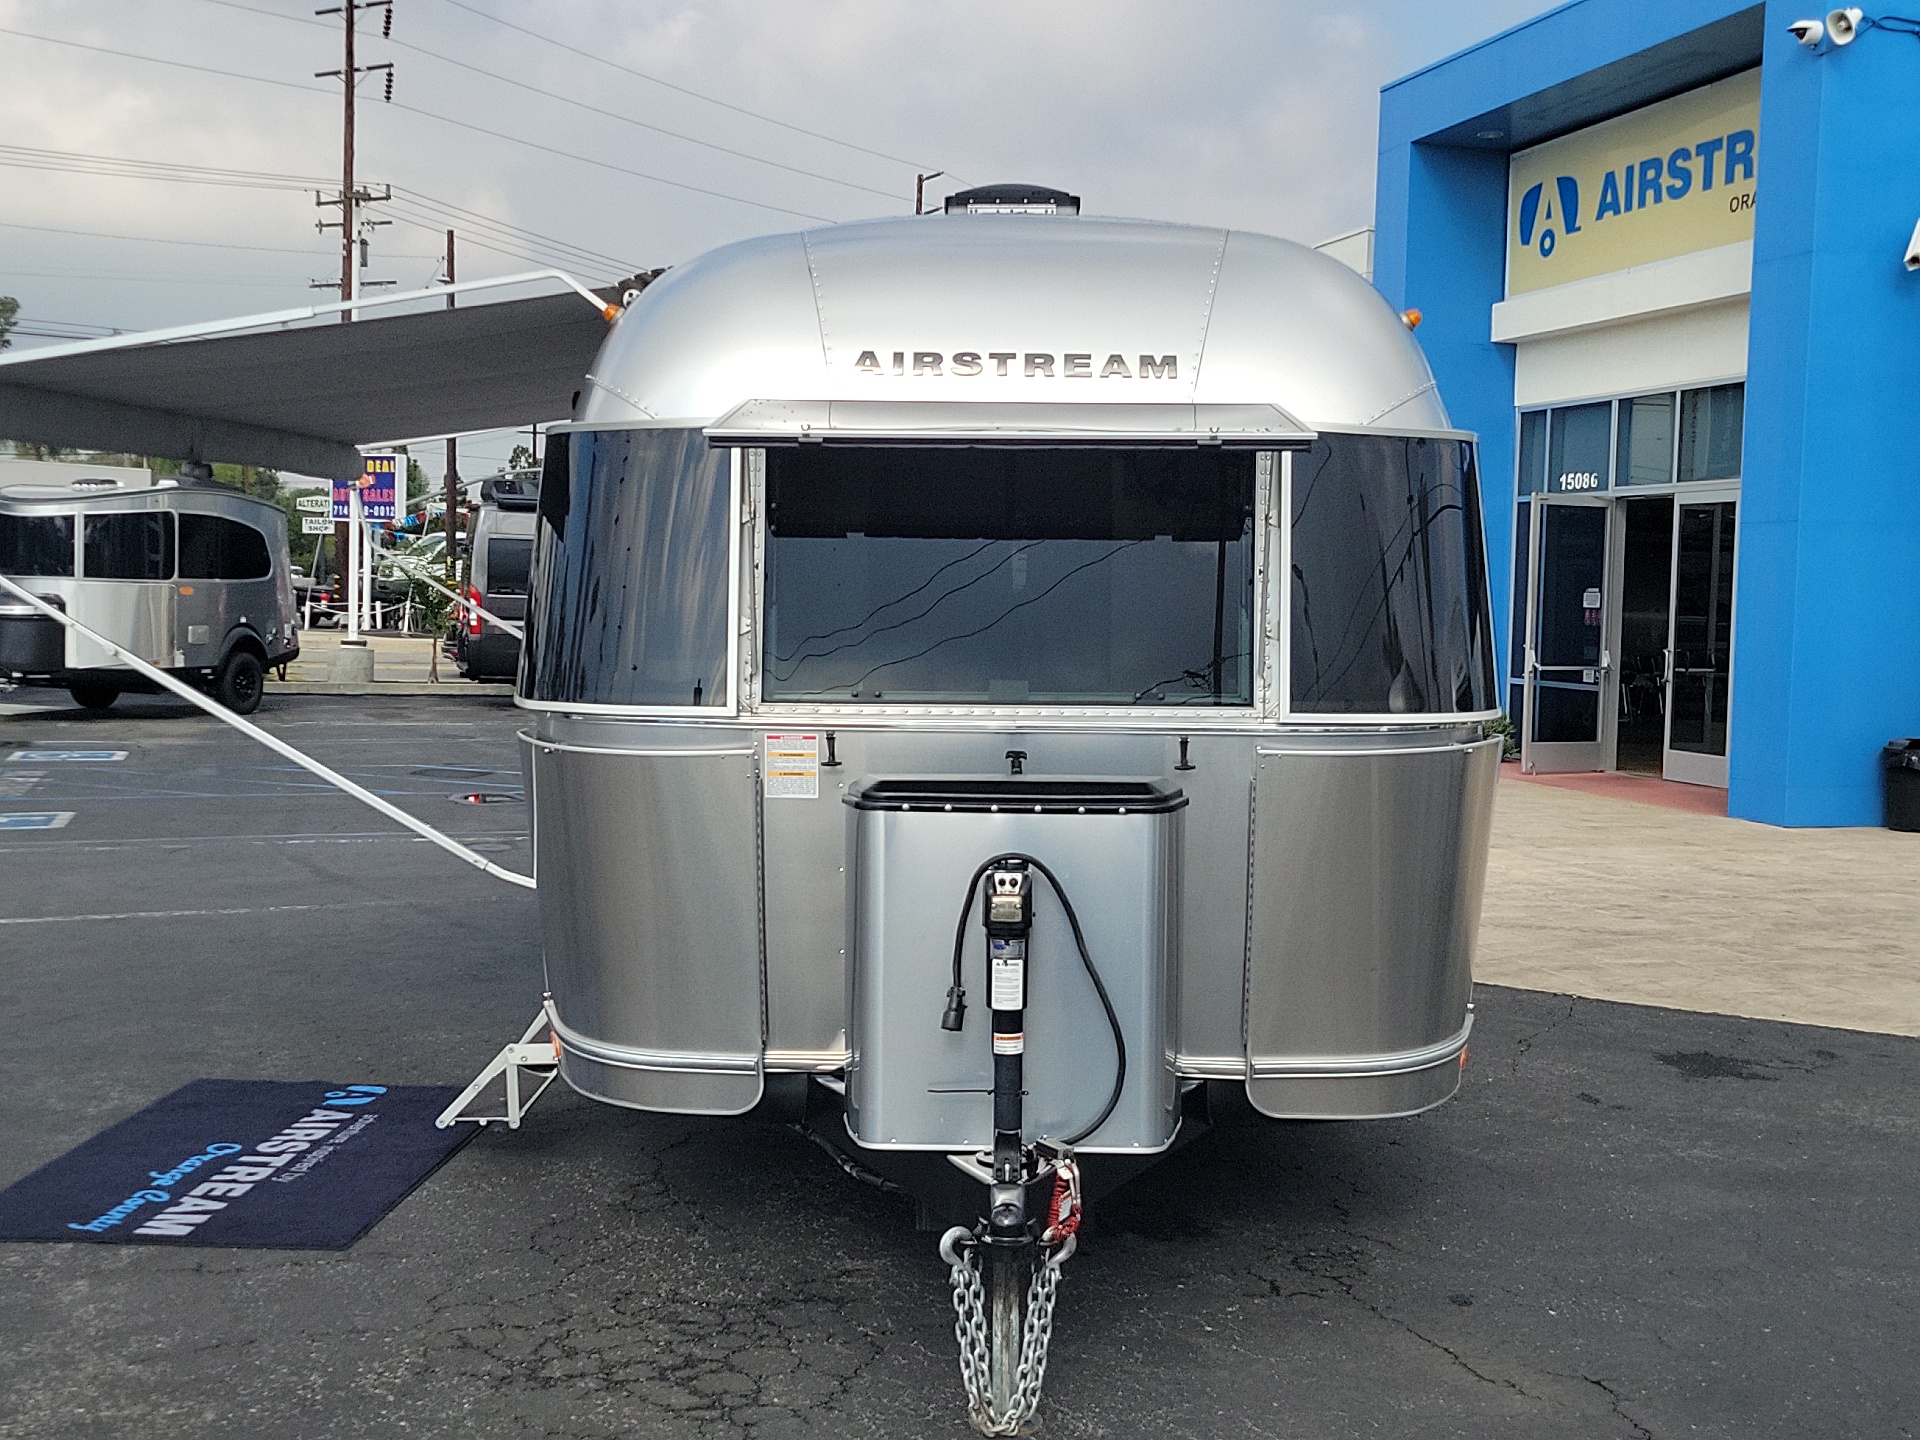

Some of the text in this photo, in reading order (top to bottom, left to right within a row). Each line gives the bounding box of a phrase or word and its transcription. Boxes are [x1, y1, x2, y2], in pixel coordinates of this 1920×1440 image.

[853, 350, 1178, 379] AIRSTREAM
[362, 488, 395, 502] SALES
[1559, 472, 1599, 490] 15086
[132, 1108, 354, 1236] AIRSTREAM
[67, 1142, 242, 1233] Orange County
